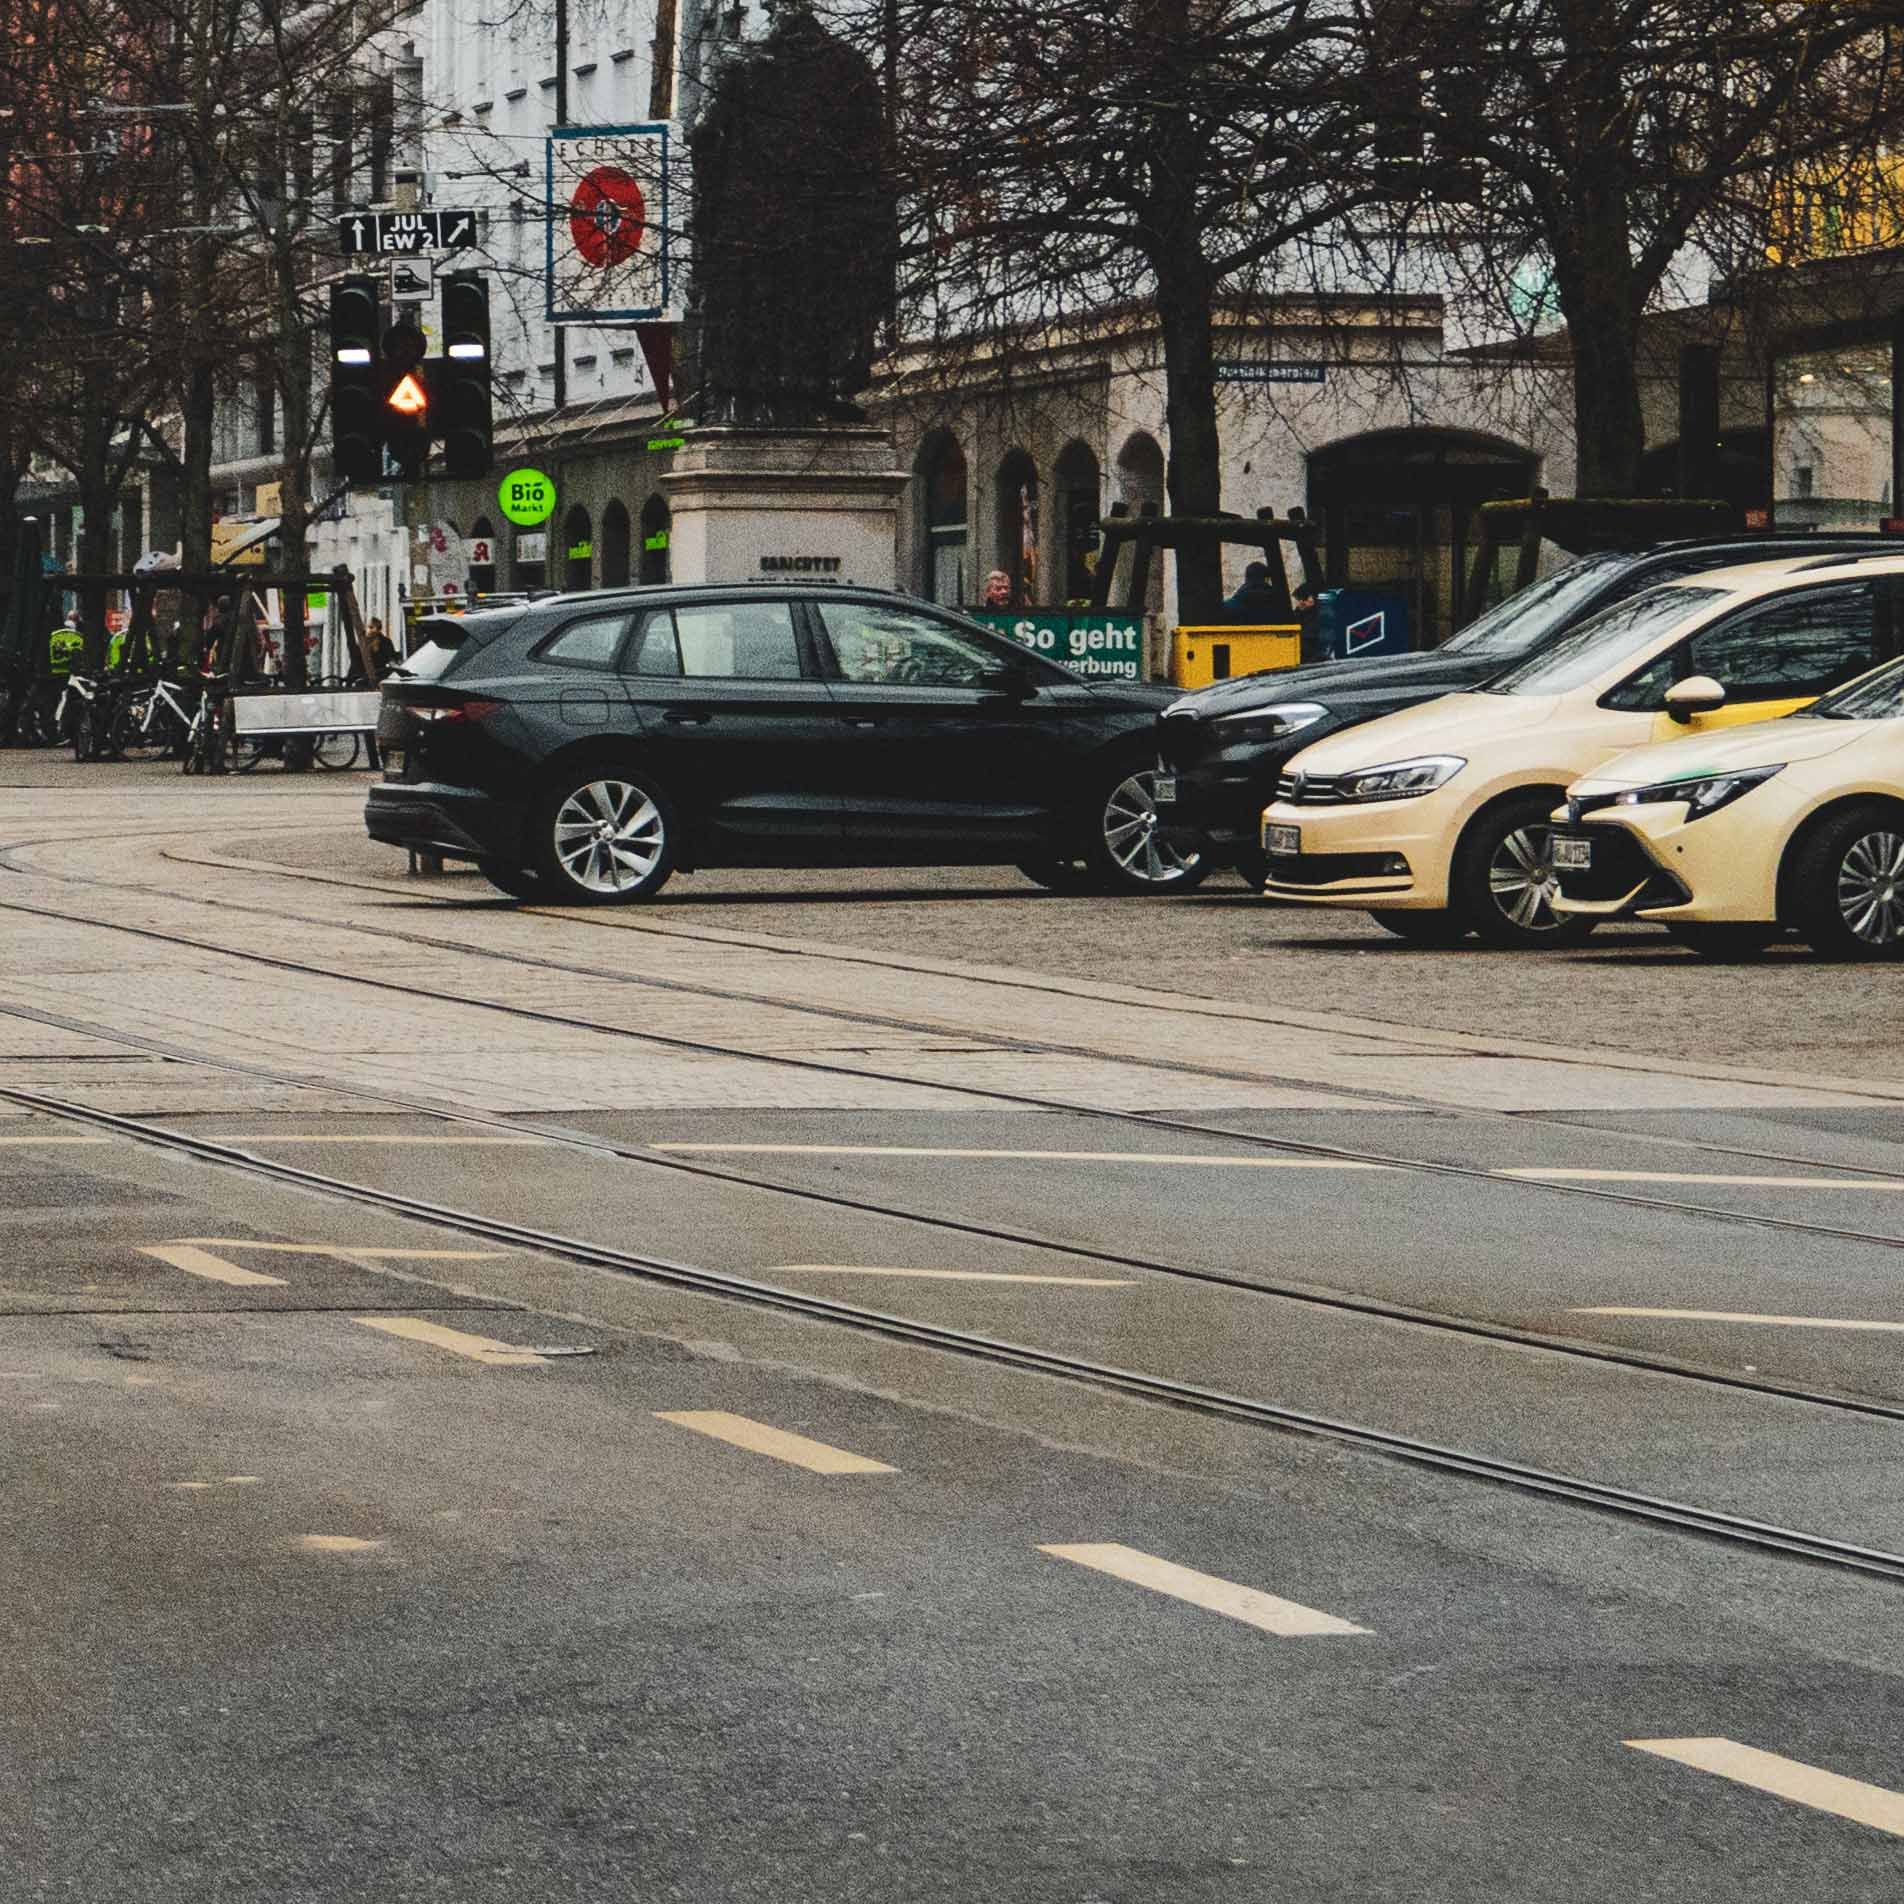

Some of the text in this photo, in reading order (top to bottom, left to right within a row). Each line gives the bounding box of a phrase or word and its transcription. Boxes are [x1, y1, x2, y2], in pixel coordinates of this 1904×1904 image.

[390, 214, 428, 232] JUL
[383, 233, 434, 250] EW 2
[511, 504, 544, 512] Markt
[1014, 621, 1137, 655] So geht
